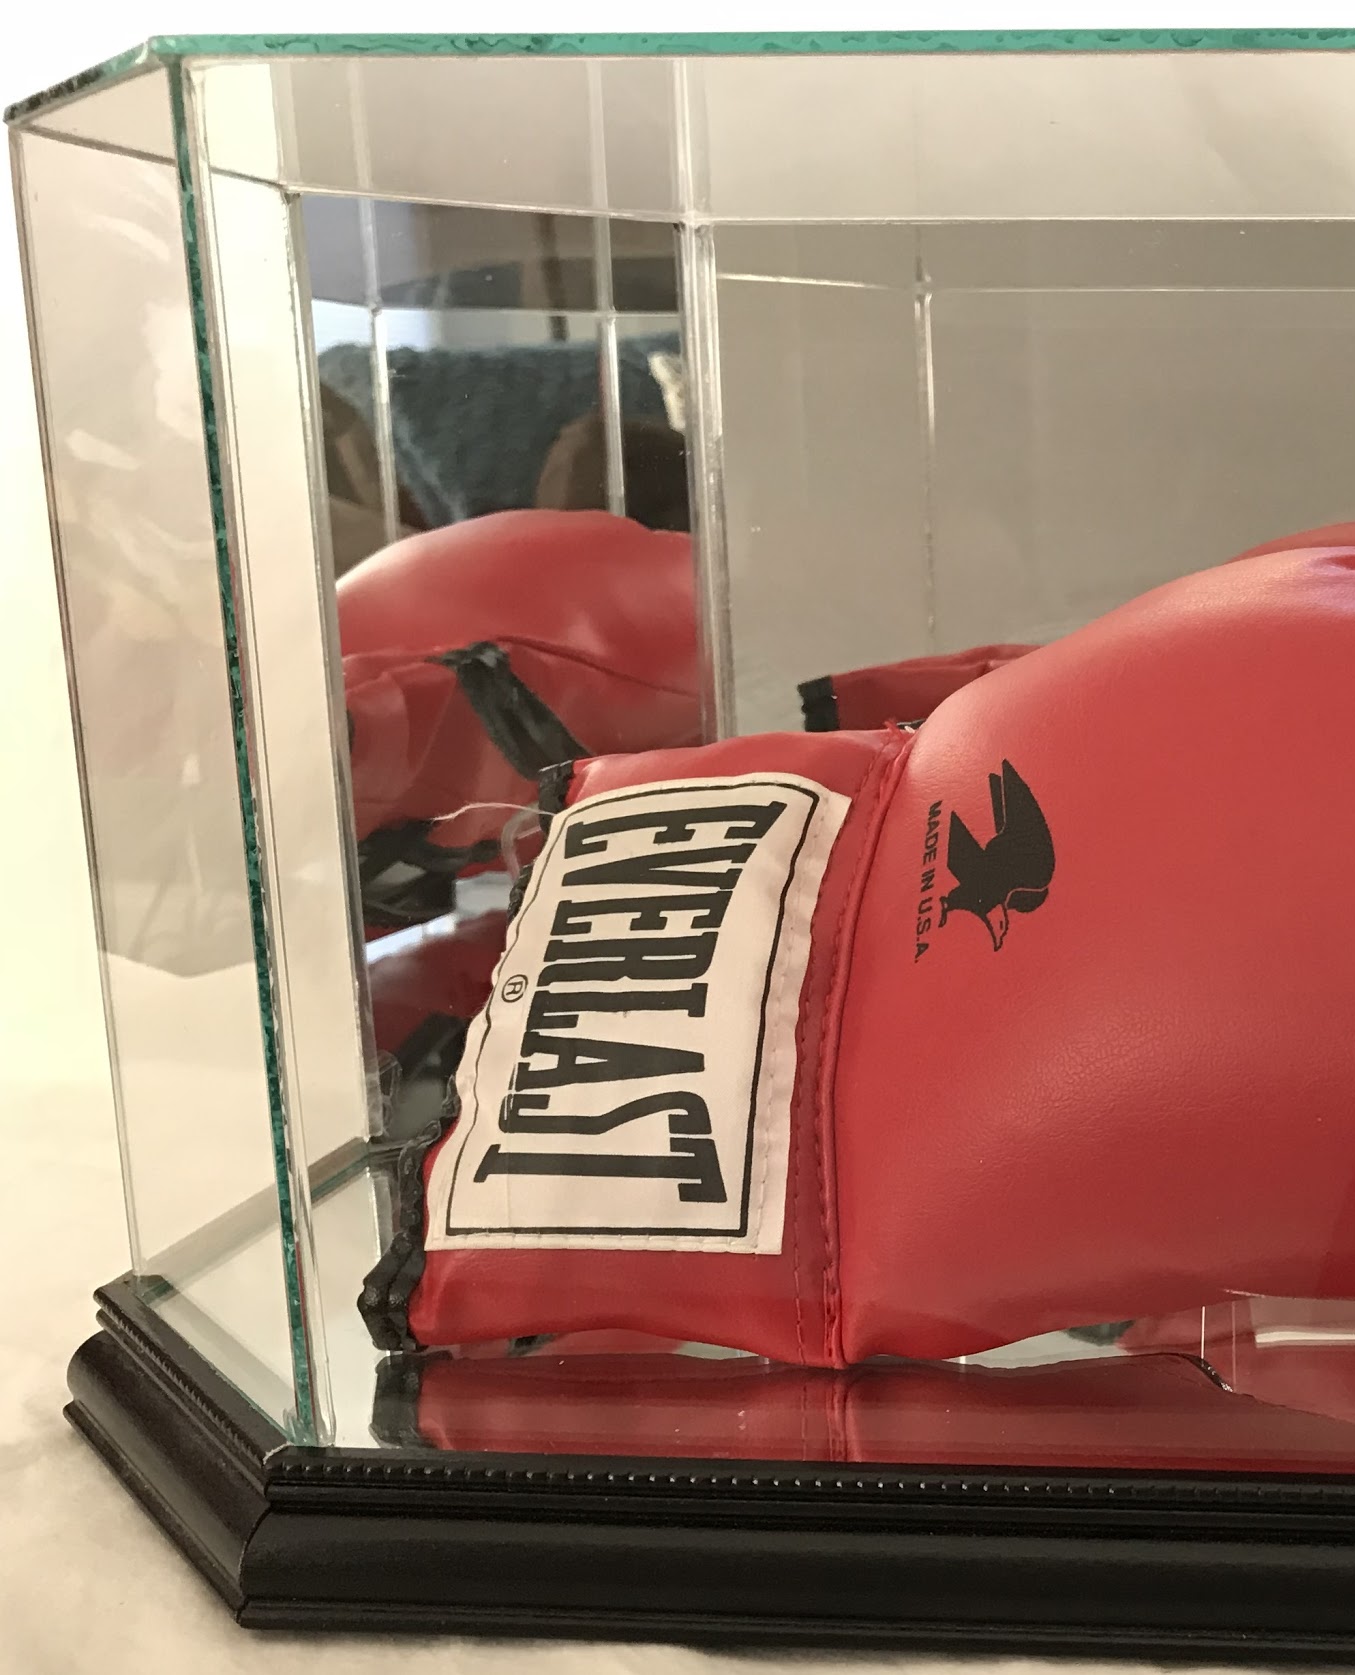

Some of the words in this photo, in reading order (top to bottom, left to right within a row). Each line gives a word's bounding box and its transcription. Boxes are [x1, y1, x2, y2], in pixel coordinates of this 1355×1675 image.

[923, 800, 943, 866] MADE
[920, 868, 936, 893] IN
[914, 896, 933, 964] U.S.A.
[473, 801, 788, 1203] EVERLAST
